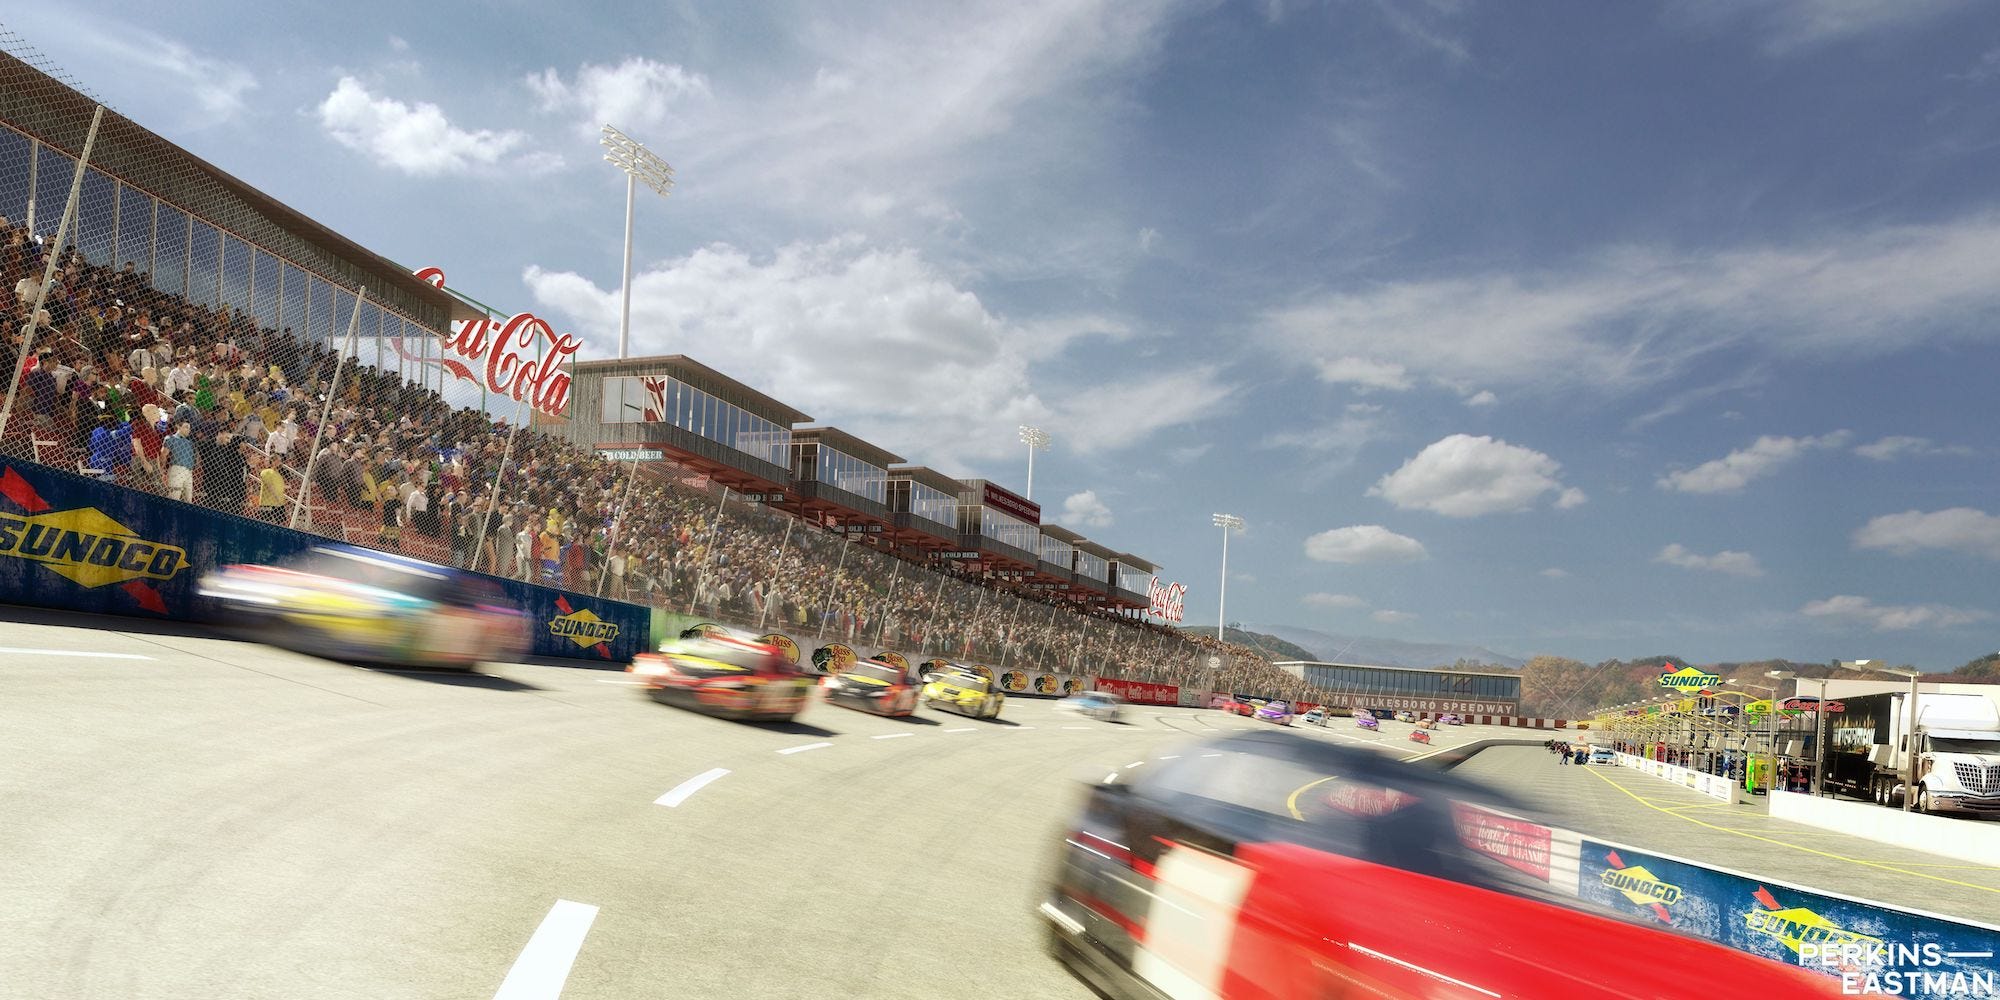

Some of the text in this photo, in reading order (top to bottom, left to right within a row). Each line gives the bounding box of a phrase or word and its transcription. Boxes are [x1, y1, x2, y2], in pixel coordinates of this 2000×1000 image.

[412, 266, 583, 417] a-Cola
[615, 450, 663, 460] COLD BEER
[762, 494, 784, 502] BER
[946, 551, 979, 559] COLD BEER
[552, 618, 617, 640] SUNOCO
[771, 635, 792, 649] Bass
[832, 645, 851, 656] Bass
[1661, 675, 1719, 687] SUNOCO
[1354, 697, 1436, 710] WILKESBORO
[1442, 702, 1513, 714] SPEEDWAY
[1603, 871, 1678, 903] SUNOCO
